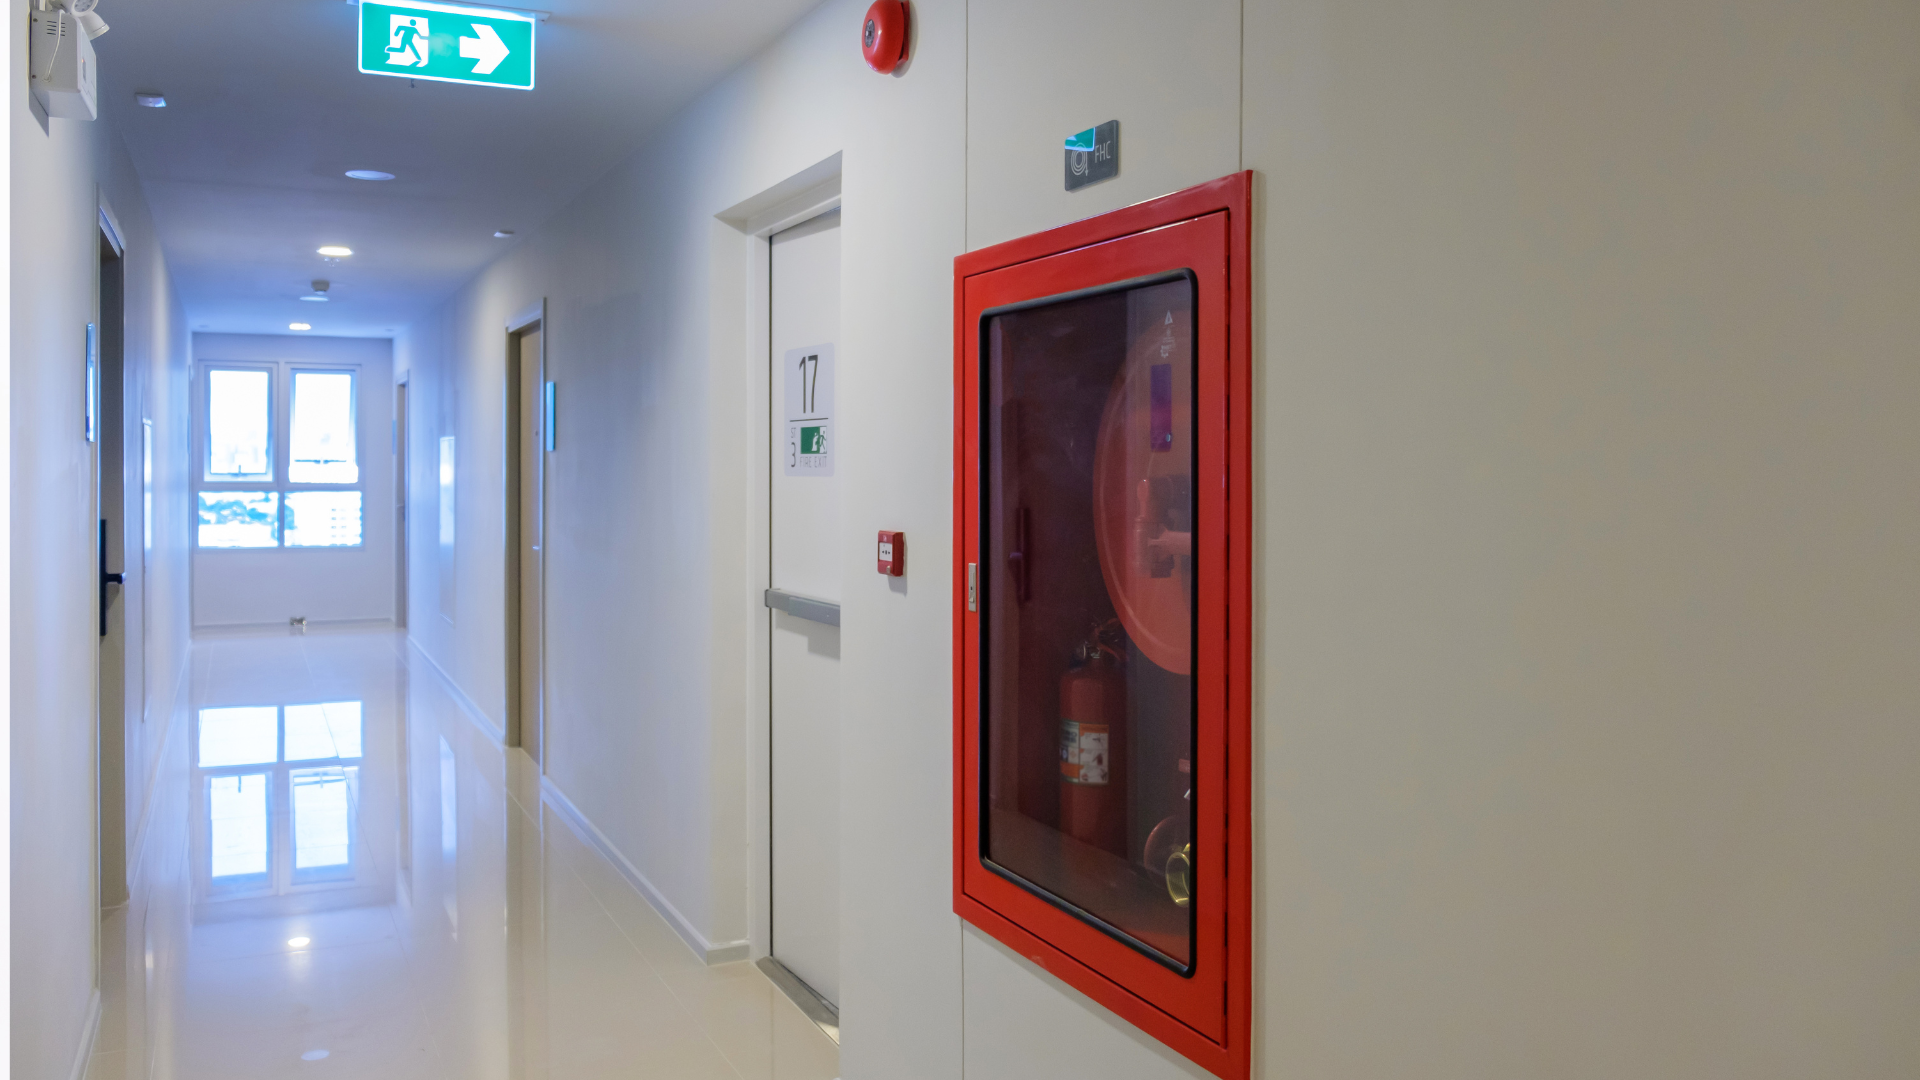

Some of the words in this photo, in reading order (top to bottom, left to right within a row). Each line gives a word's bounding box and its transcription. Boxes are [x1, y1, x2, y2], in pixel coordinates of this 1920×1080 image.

[1094, 141, 1111, 163] FHC
[798, 354, 819, 414] 17
[790, 441, 797, 468] 3
[799, 456, 812, 468] FIRE
[814, 455, 827, 468] EXIT
